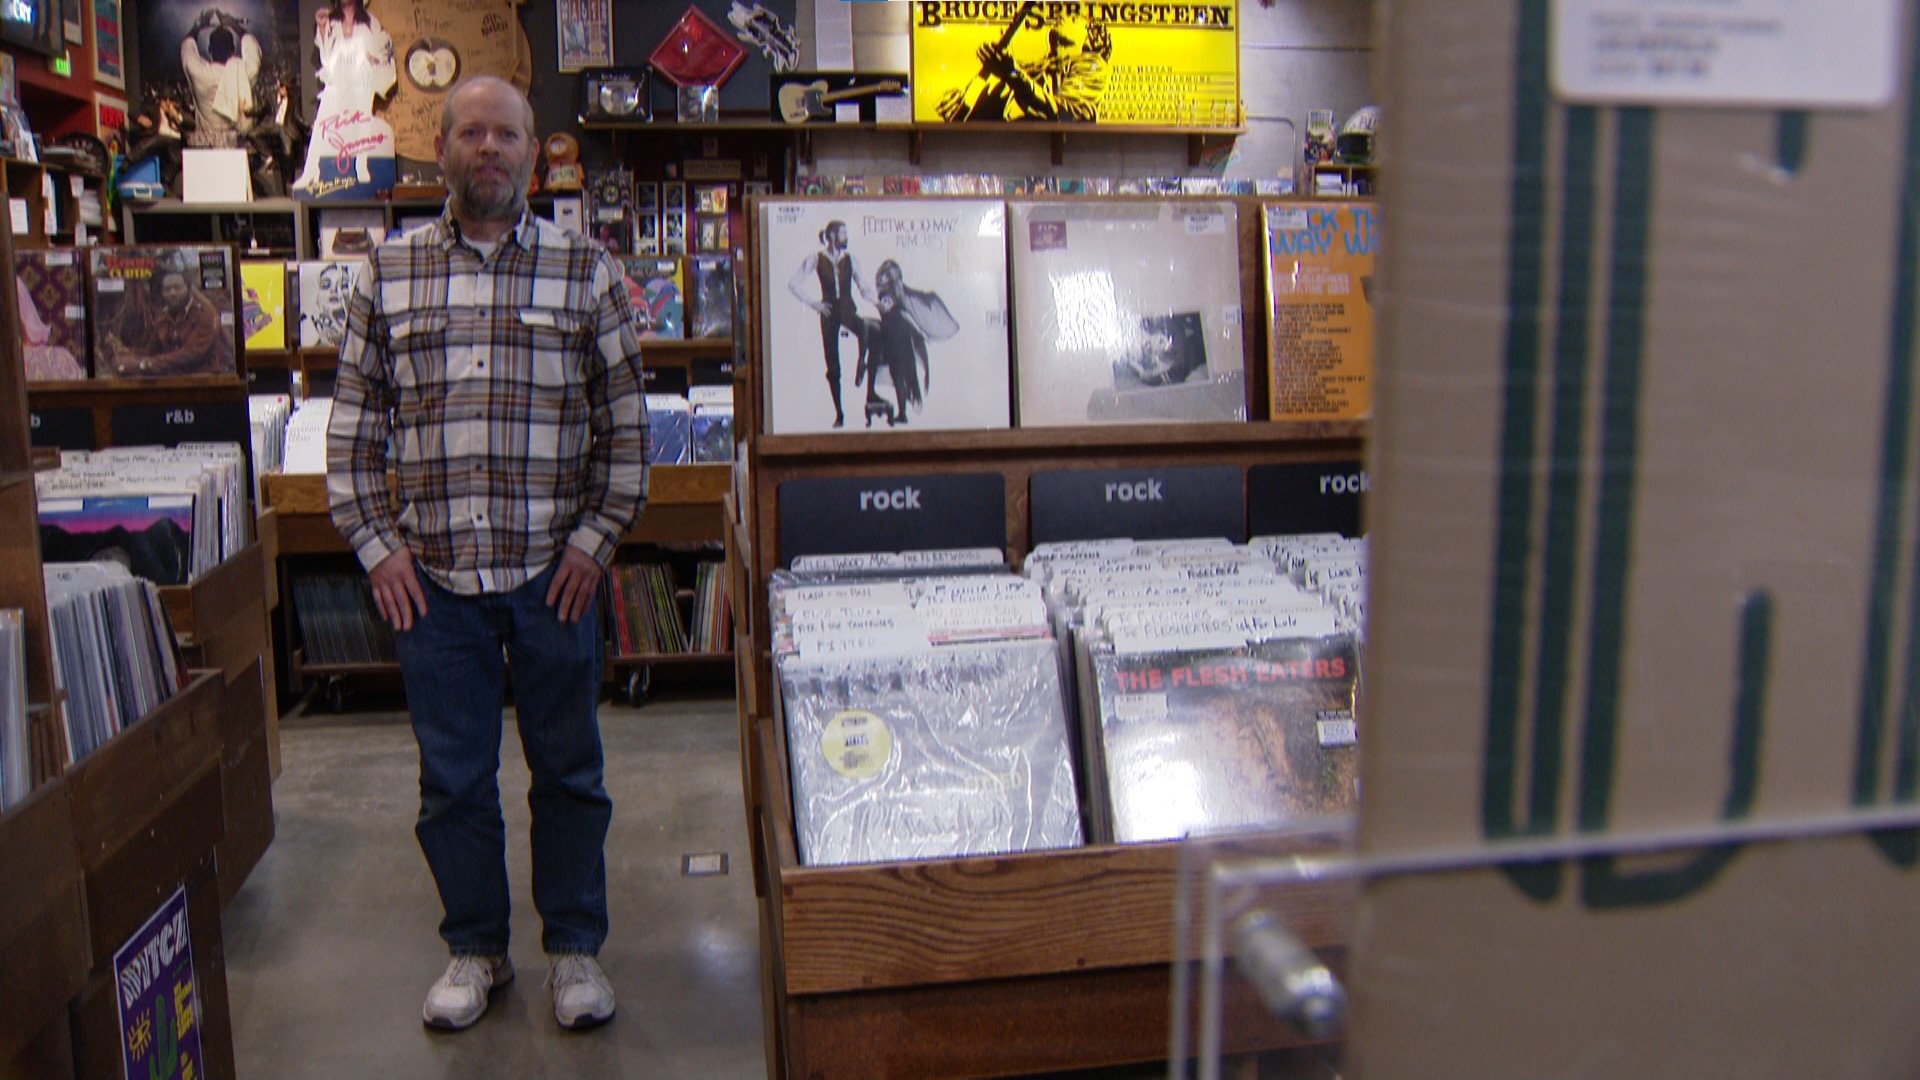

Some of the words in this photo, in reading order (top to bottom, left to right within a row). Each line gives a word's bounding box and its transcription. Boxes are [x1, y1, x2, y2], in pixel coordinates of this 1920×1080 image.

[918, 0, 1017, 27] BRUCE
[1024, 0, 1232, 30] SPRINGSTEEN
[320, 109, 371, 140] Rick
[1307, 208, 1339, 232] CK
[1272, 230, 1333, 256] WAY
[165, 409, 195, 425] r&b
[1105, 478, 1163, 502] rock
[1320, 473, 1372, 494] rock
[860, 486, 921, 511] rock
[1115, 669, 1163, 691] THE
[1171, 665, 1248, 688] FLESH
[1255, 658, 1346, 682] EATERS
